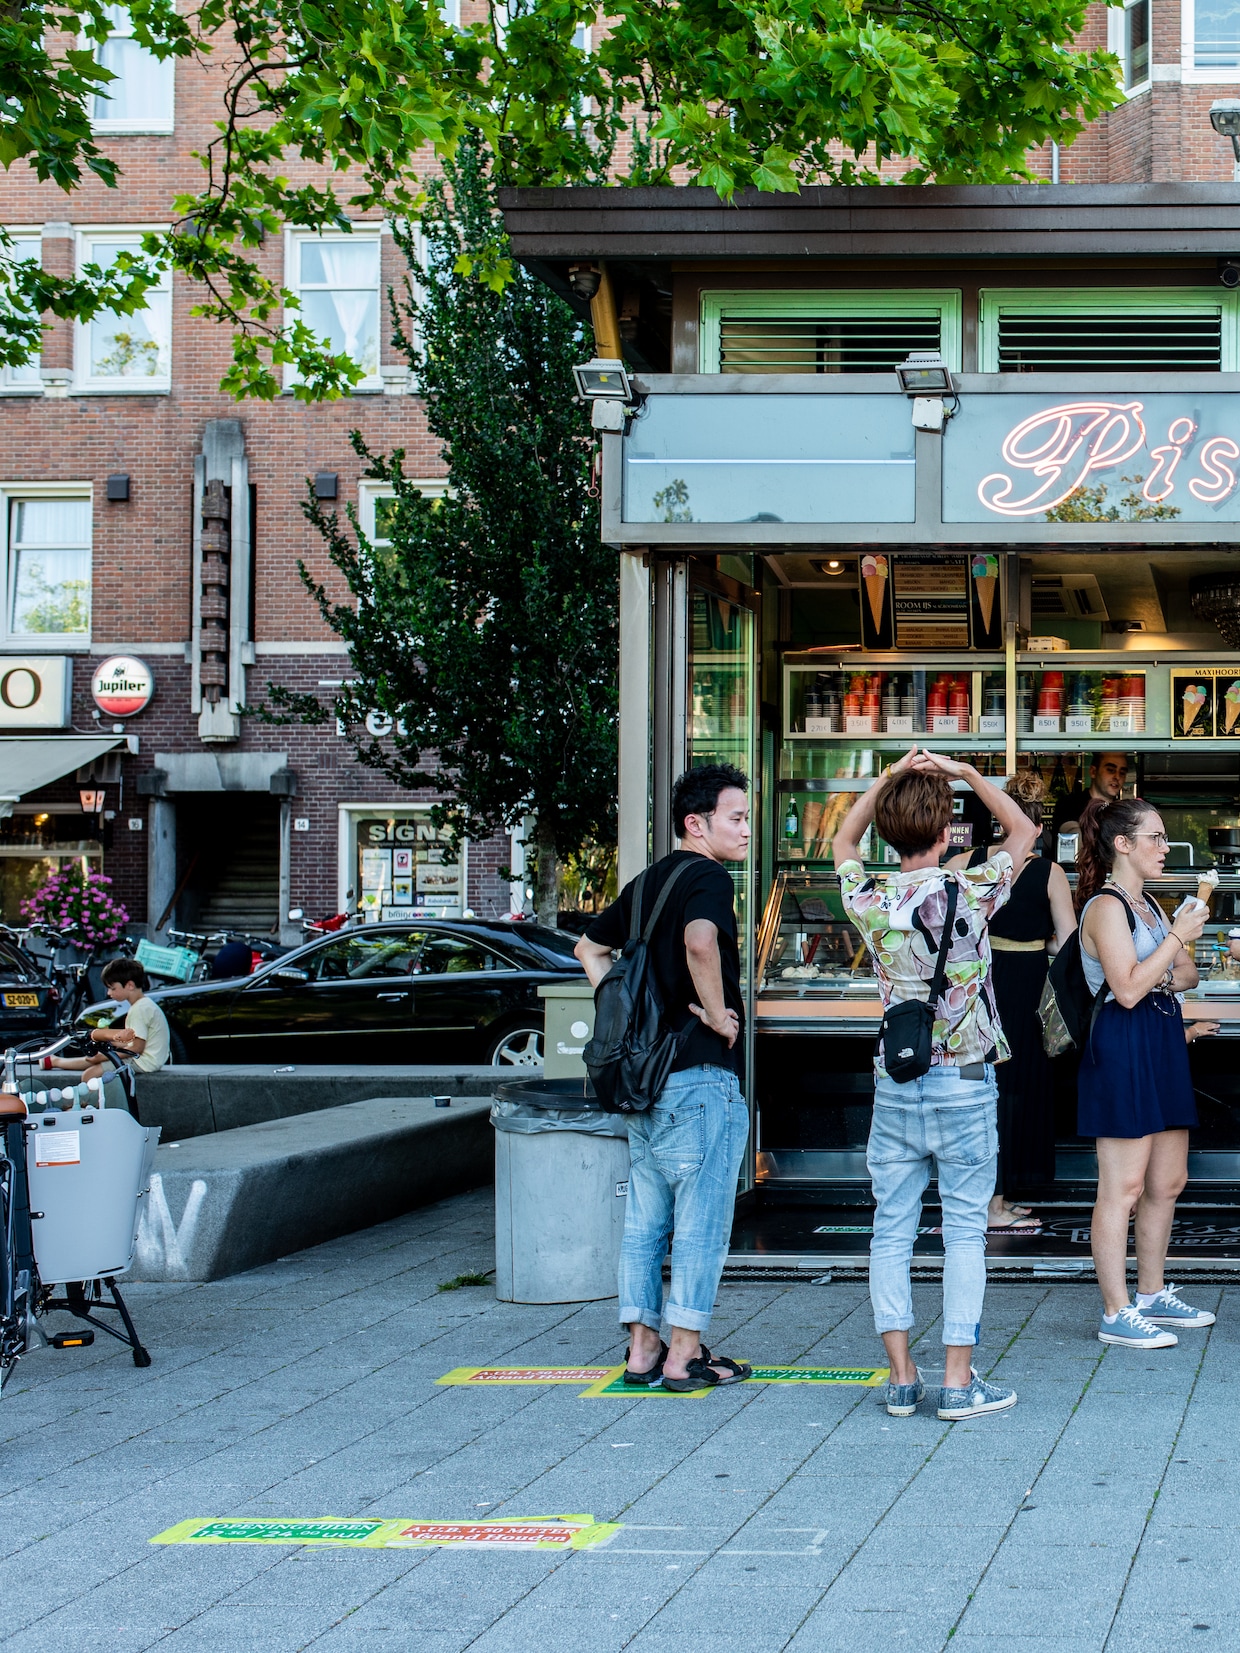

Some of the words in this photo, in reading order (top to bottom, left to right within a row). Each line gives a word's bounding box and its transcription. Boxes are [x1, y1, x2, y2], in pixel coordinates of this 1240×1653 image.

[98, 679, 146, 693] Jupiler
[298, 820, 306, 829] 14
[484, 1534, 568, 1542] Houden
